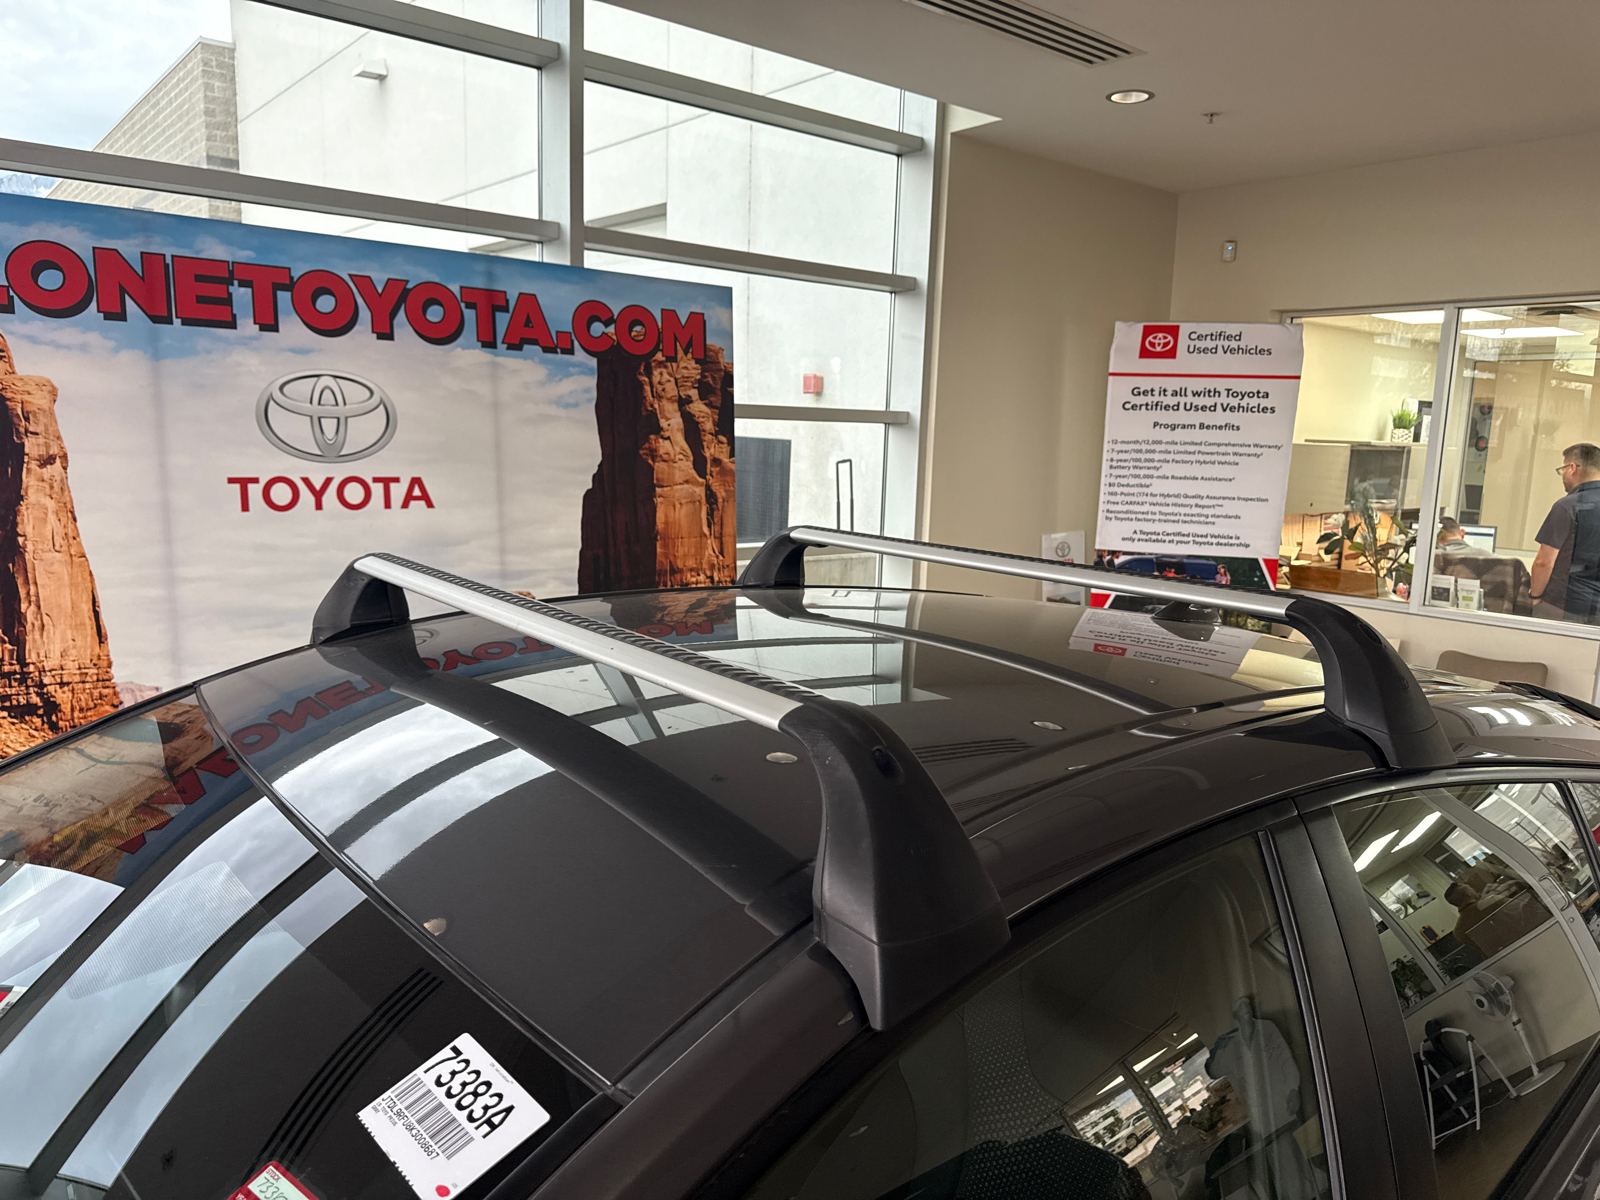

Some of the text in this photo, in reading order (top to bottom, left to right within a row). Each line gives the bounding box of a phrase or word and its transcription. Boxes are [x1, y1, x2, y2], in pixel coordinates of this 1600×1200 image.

[1188, 330, 1242, 342] Certified
[1187, 345, 1272, 356] Used Vehicles
[1131, 386, 1269, 401] Get it all with Toyota
[1122, 401, 1276, 414] Certified Used Vehicles
[1153, 421, 1241, 433] Program Benefits
[227, 475, 436, 514] TOYOTA
[423, 1044, 516, 1139] 73383A
[266, 1168, 282, 1182] STOCK
